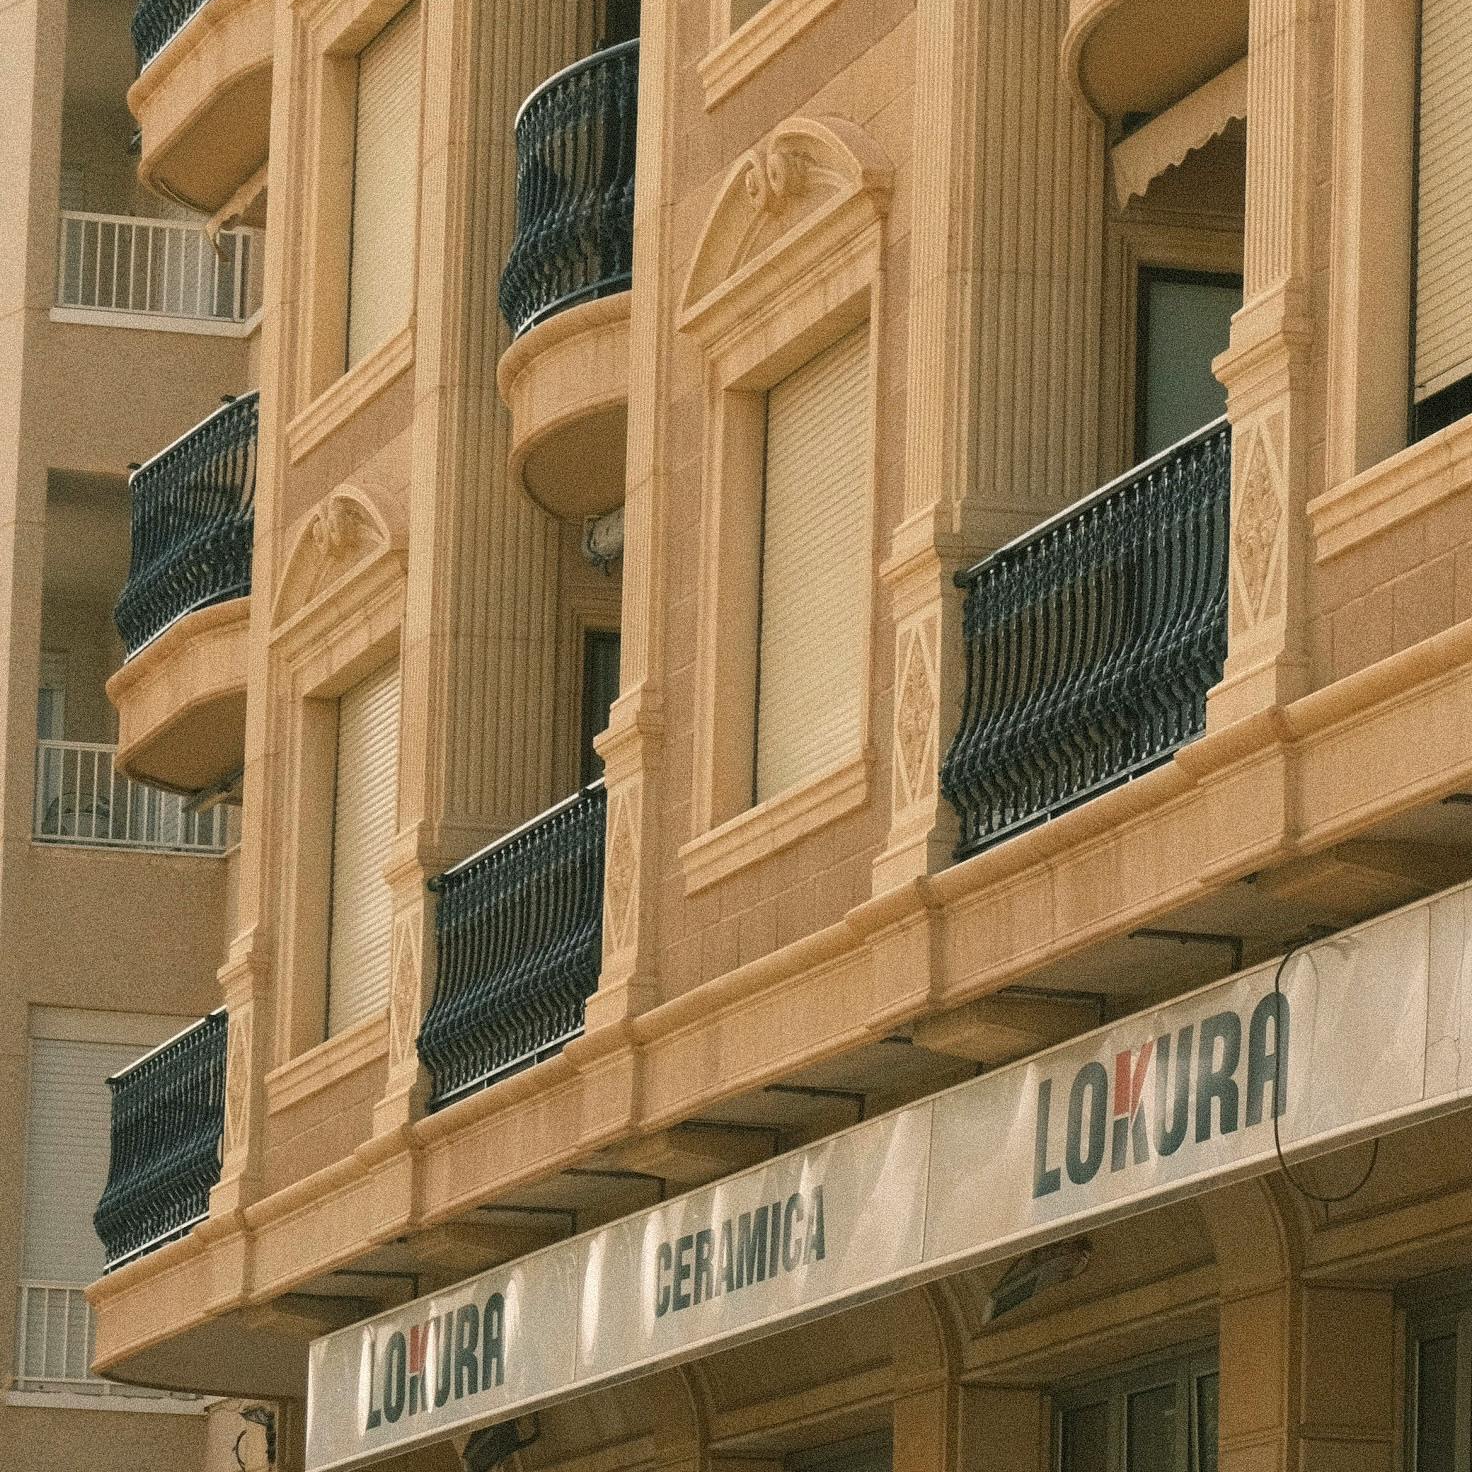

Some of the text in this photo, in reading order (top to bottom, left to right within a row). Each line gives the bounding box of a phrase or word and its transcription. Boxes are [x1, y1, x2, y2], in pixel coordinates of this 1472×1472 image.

[1032, 992, 1290, 1199] LOKURA
[656, 1185, 826, 1318] CERAMICA
[366, 1292, 505, 1430] LOKURA
